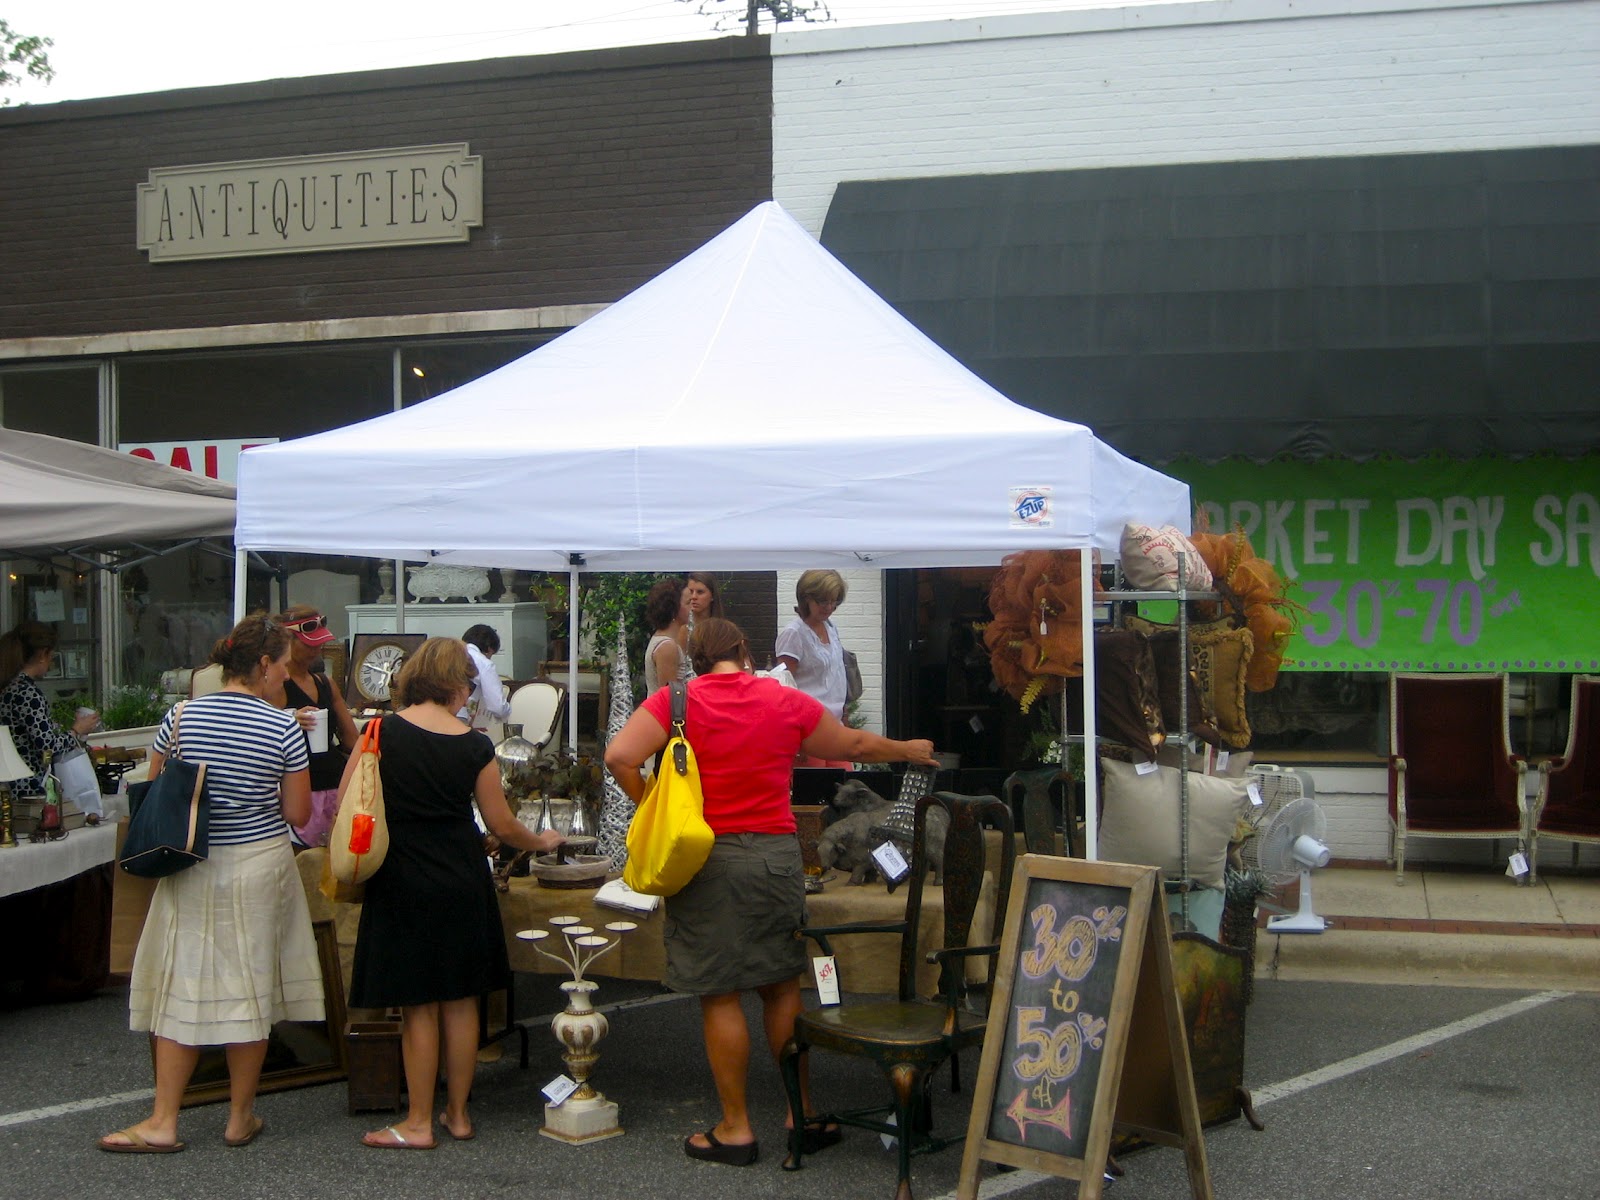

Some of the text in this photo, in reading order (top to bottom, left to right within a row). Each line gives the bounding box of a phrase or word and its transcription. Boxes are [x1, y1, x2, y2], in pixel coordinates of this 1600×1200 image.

[1193, 499, 1370, 579] ARKET
[1395, 495, 1504, 580] DAY
[1021, 903, 1127, 981] 30%
[1049, 978, 1080, 1013] to
[1012, 1005, 1107, 1082] 50%
